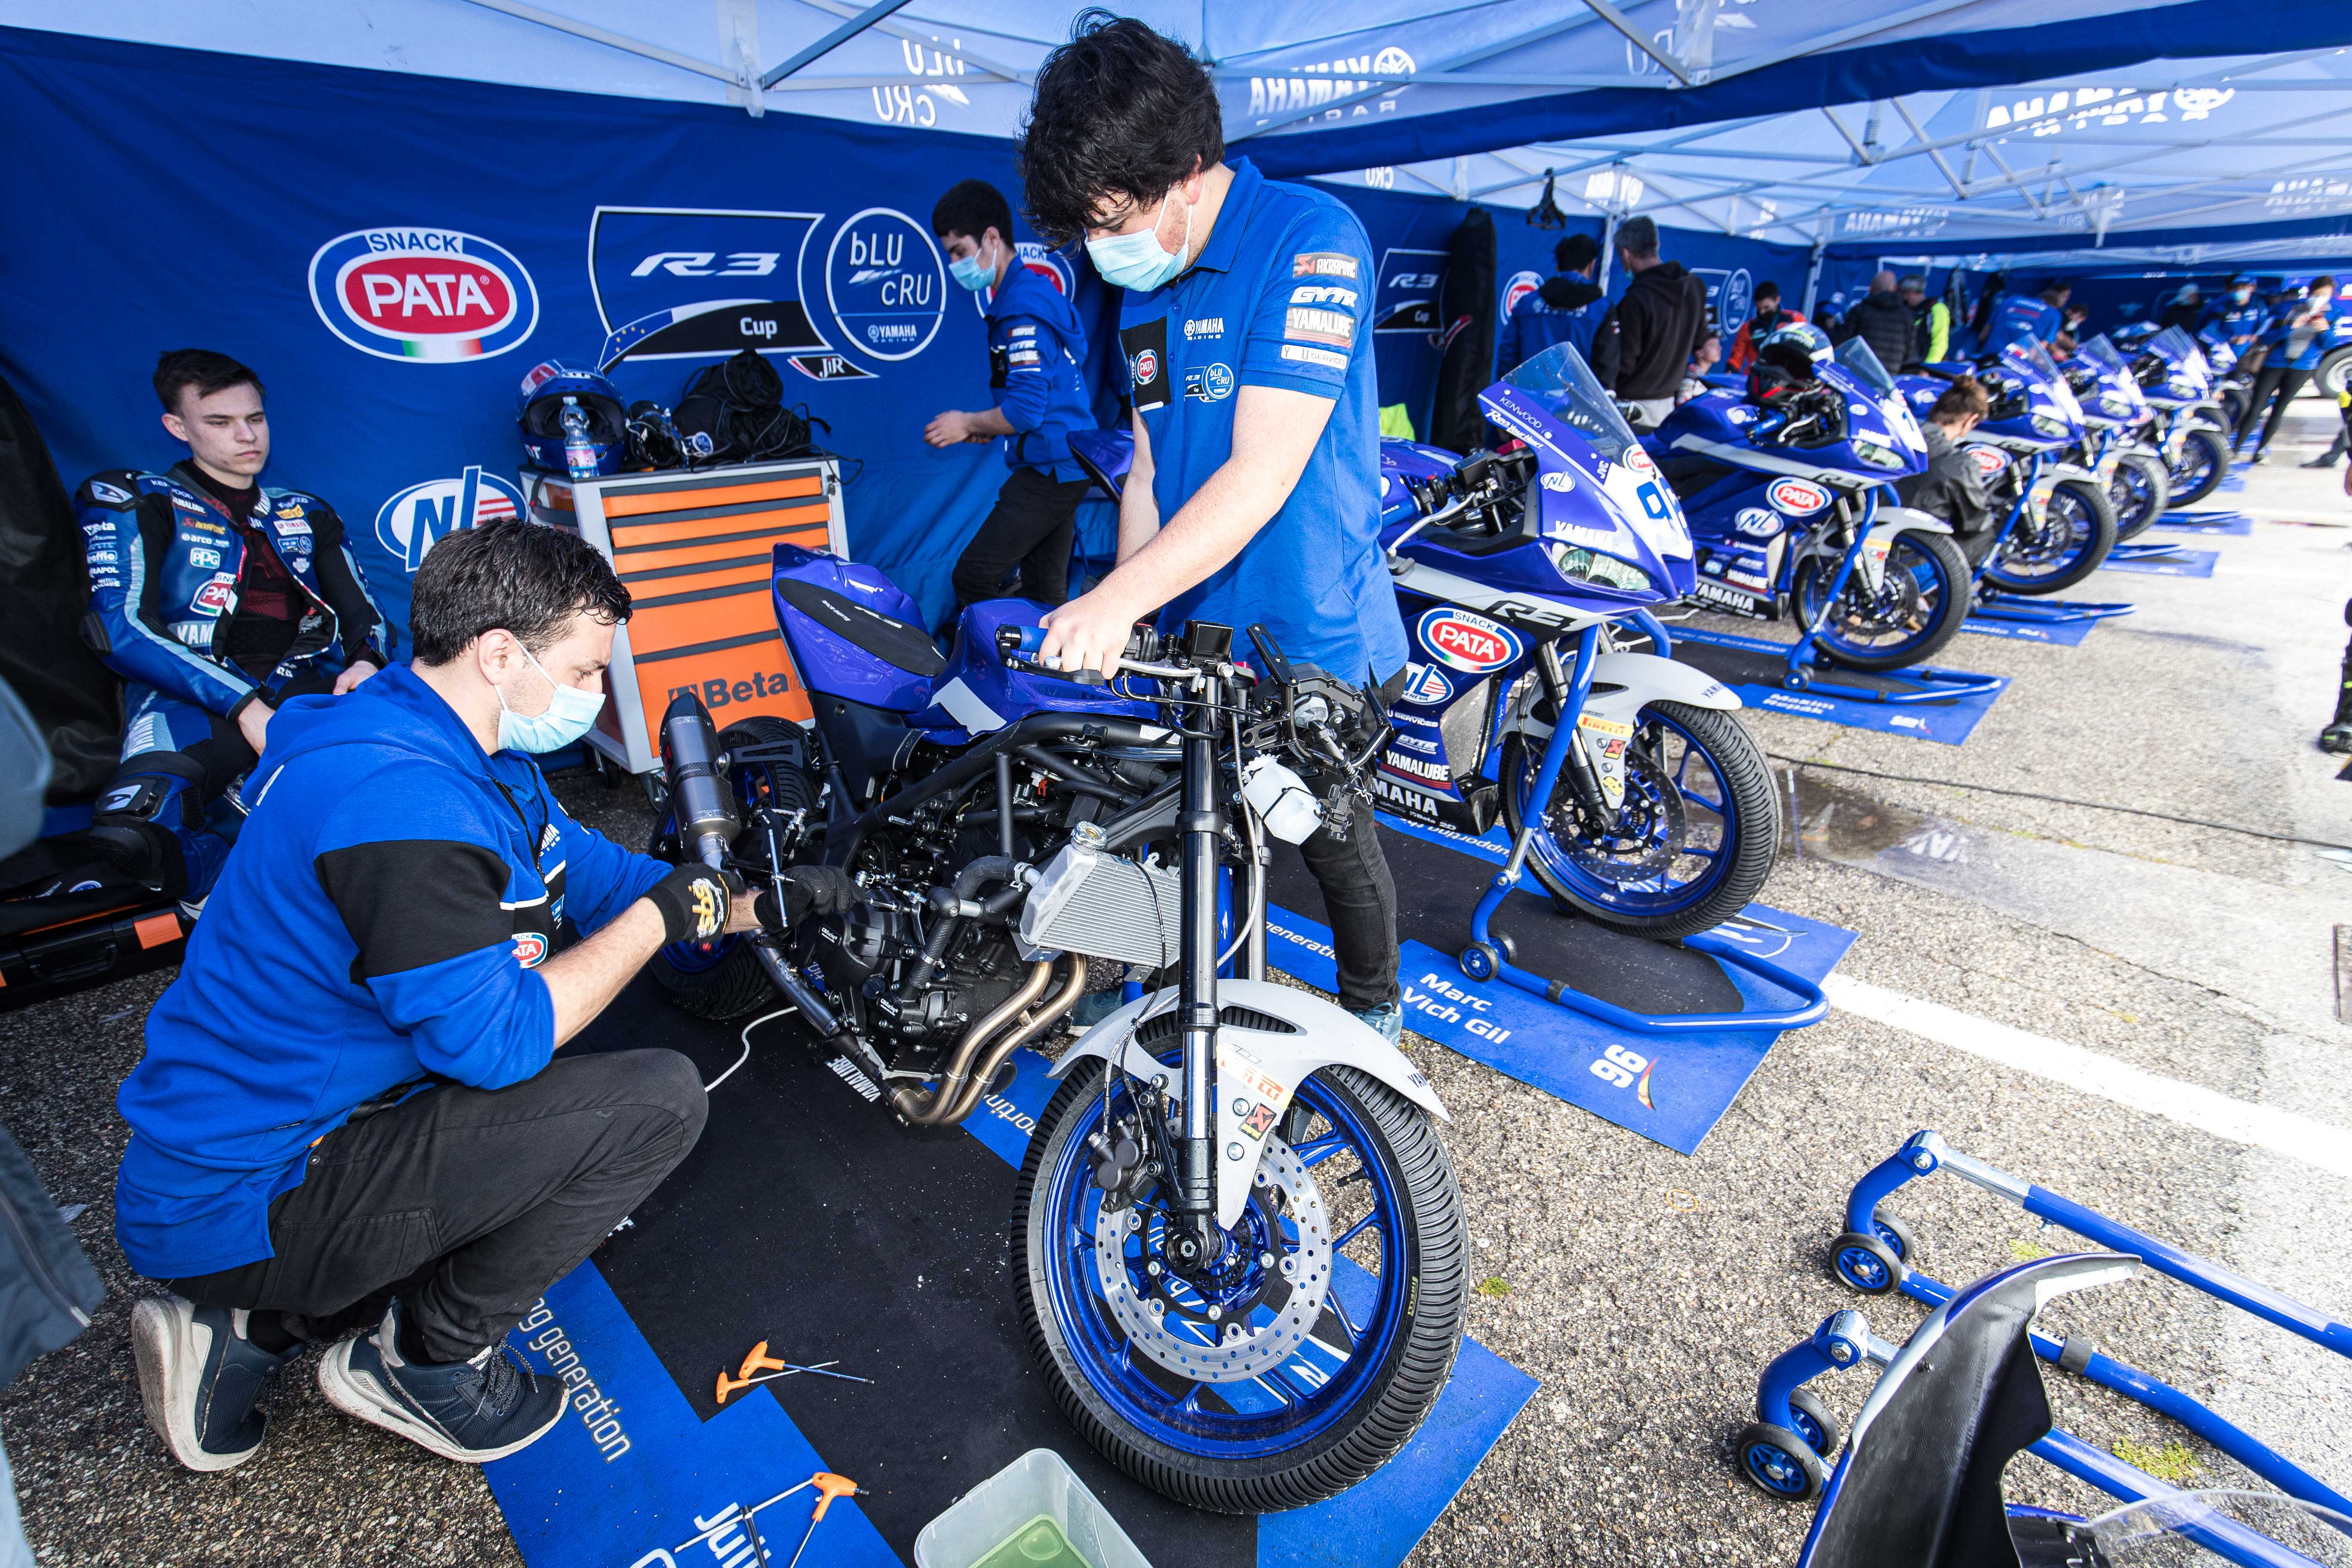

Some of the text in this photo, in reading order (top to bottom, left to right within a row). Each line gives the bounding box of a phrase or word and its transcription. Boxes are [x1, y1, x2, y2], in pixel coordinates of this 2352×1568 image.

[368, 232, 459, 254] SNACK
[1018, 246, 1045, 261] ACK
[630, 252, 781, 277] R3
[1389, 273, 1439, 288] R3
[361, 273, 495, 317] PATA
[1289, 286, 1358, 308] GYTR
[740, 316, 778, 339] Cup
[879, 323, 917, 338] YAMAHA
[1195, 317, 1225, 334] YAMAHA
[1292, 308, 1351, 337] YAMALUBE
[1140, 360, 1154, 374] PATA
[1284, 346, 1346, 366] YU SERVICES
[1499, 397, 1542, 429] KENWOOD
[1596, 459, 1609, 480] JVC
[1780, 487, 1816, 508] PATA
[1555, 520, 1614, 552] YAMAHA
[1455, 612, 1497, 631] SNACK
[1439, 625, 1496, 660] PATA
[703, 672, 789, 709] Beta
[1394, 711, 1439, 728] SERVICES
[1582, 717, 1626, 735] PIRELLI
[1397, 734, 1439, 750] GYTR
[1386, 750, 1450, 781] YAMALUBE
[1420, 973, 1493, 1012] Marc
[1403, 986, 1512, 1045] Vich Gil
[1407, 1275, 1418, 1317] PIRELLI
[528, 1326, 633, 1463] generation
